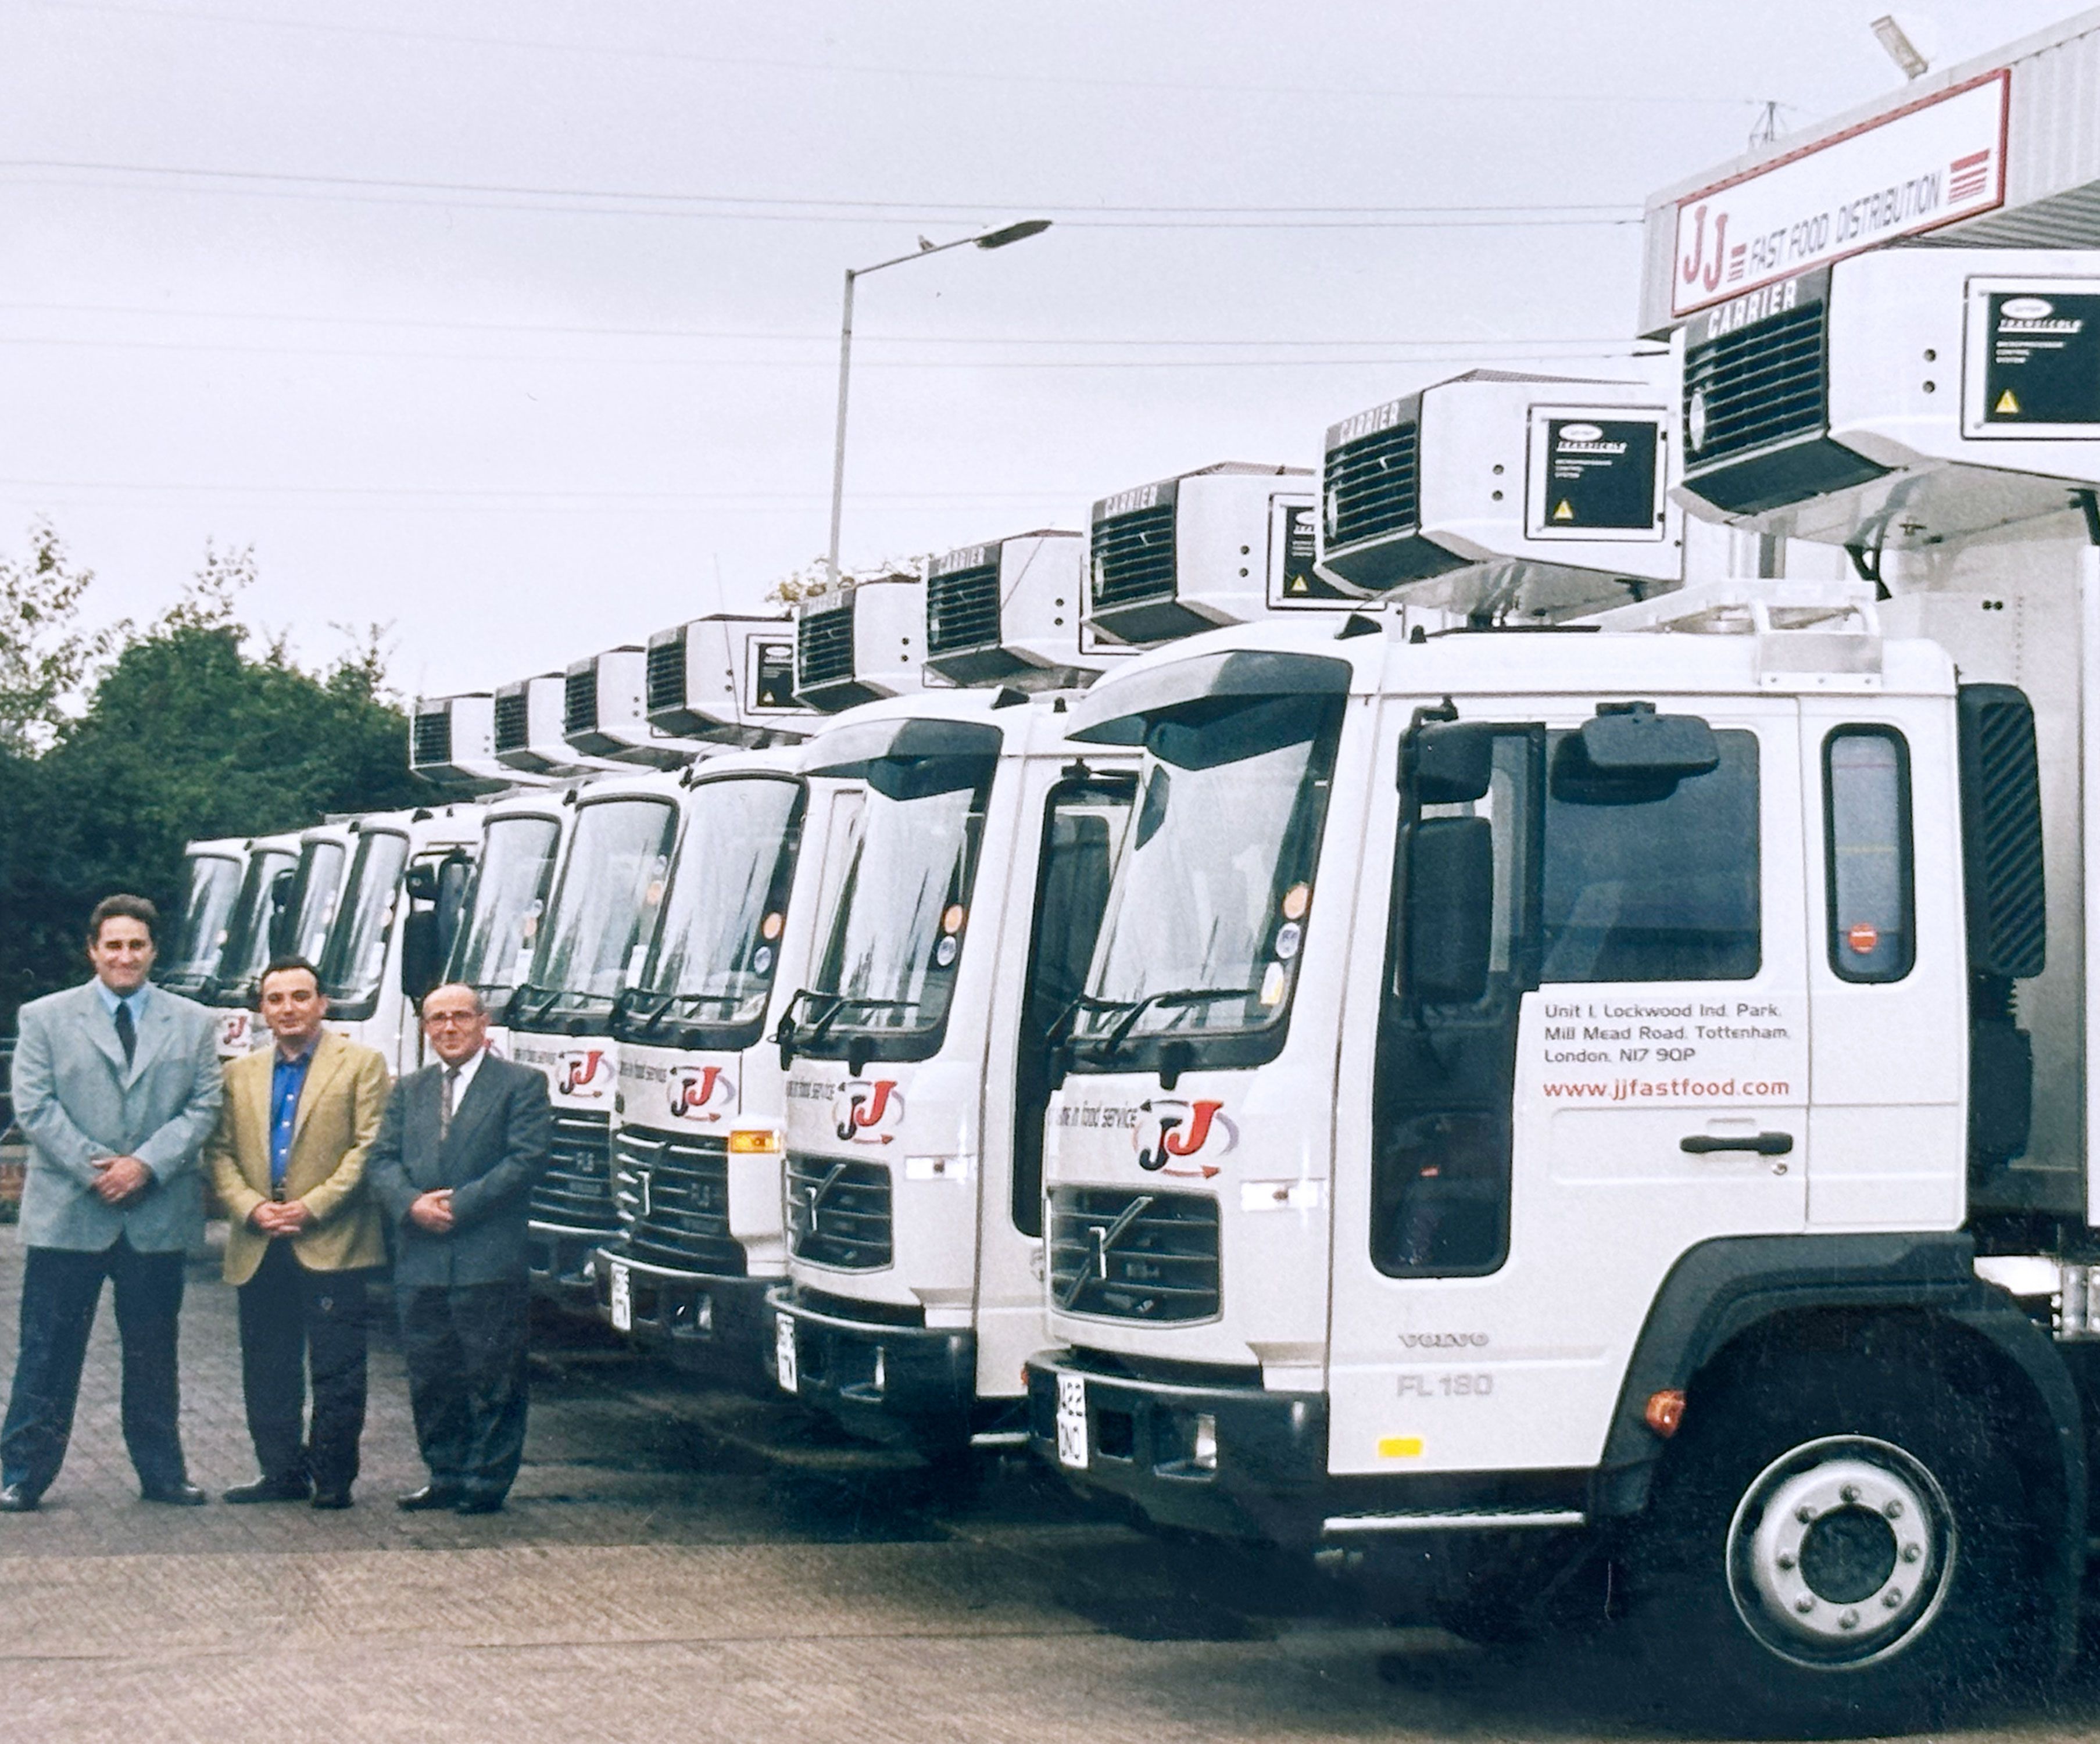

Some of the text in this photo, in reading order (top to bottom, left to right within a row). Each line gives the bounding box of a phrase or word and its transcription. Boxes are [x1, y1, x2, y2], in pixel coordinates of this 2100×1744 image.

[1684, 172, 1941, 292] JJ FAST FOOD DISTRIBUTION
[1708, 280, 1797, 338] CARRIER
[1339, 401, 1400, 445] CARRIER
[1545, 1004, 1580, 1018] Unit
[1604, 1004, 1692, 1018] Lockwood
[1545, 1026, 1576, 1040] Mill
[1583, 1026, 1632, 1040] Mead
[1543, 1079, 1789, 1101] www.jjfastfood.com
[1140, 1098, 1224, 1171] JJ
[1397, 1332, 1490, 1348] VOLVO
